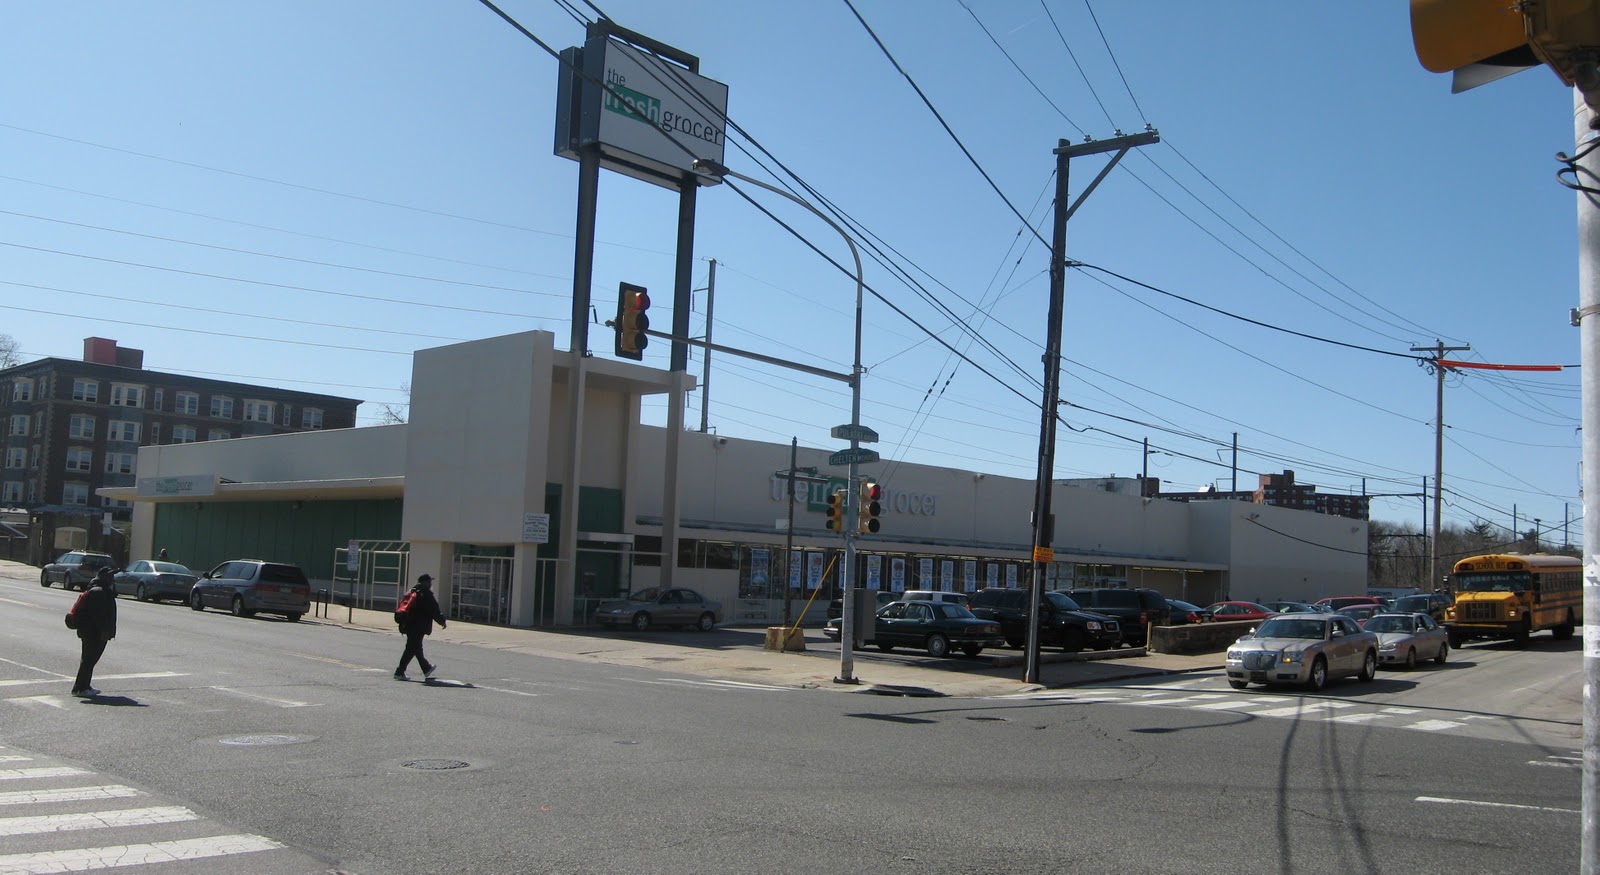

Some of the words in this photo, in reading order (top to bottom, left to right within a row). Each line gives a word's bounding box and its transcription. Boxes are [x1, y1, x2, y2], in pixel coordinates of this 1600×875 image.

[607, 67, 626, 87] the
[604, 83, 660, 126] fresh
[660, 110, 721, 144] grocer
[1475, 562, 1494, 570] SCHOOL
[1495, 561, 1506, 570] BUS
